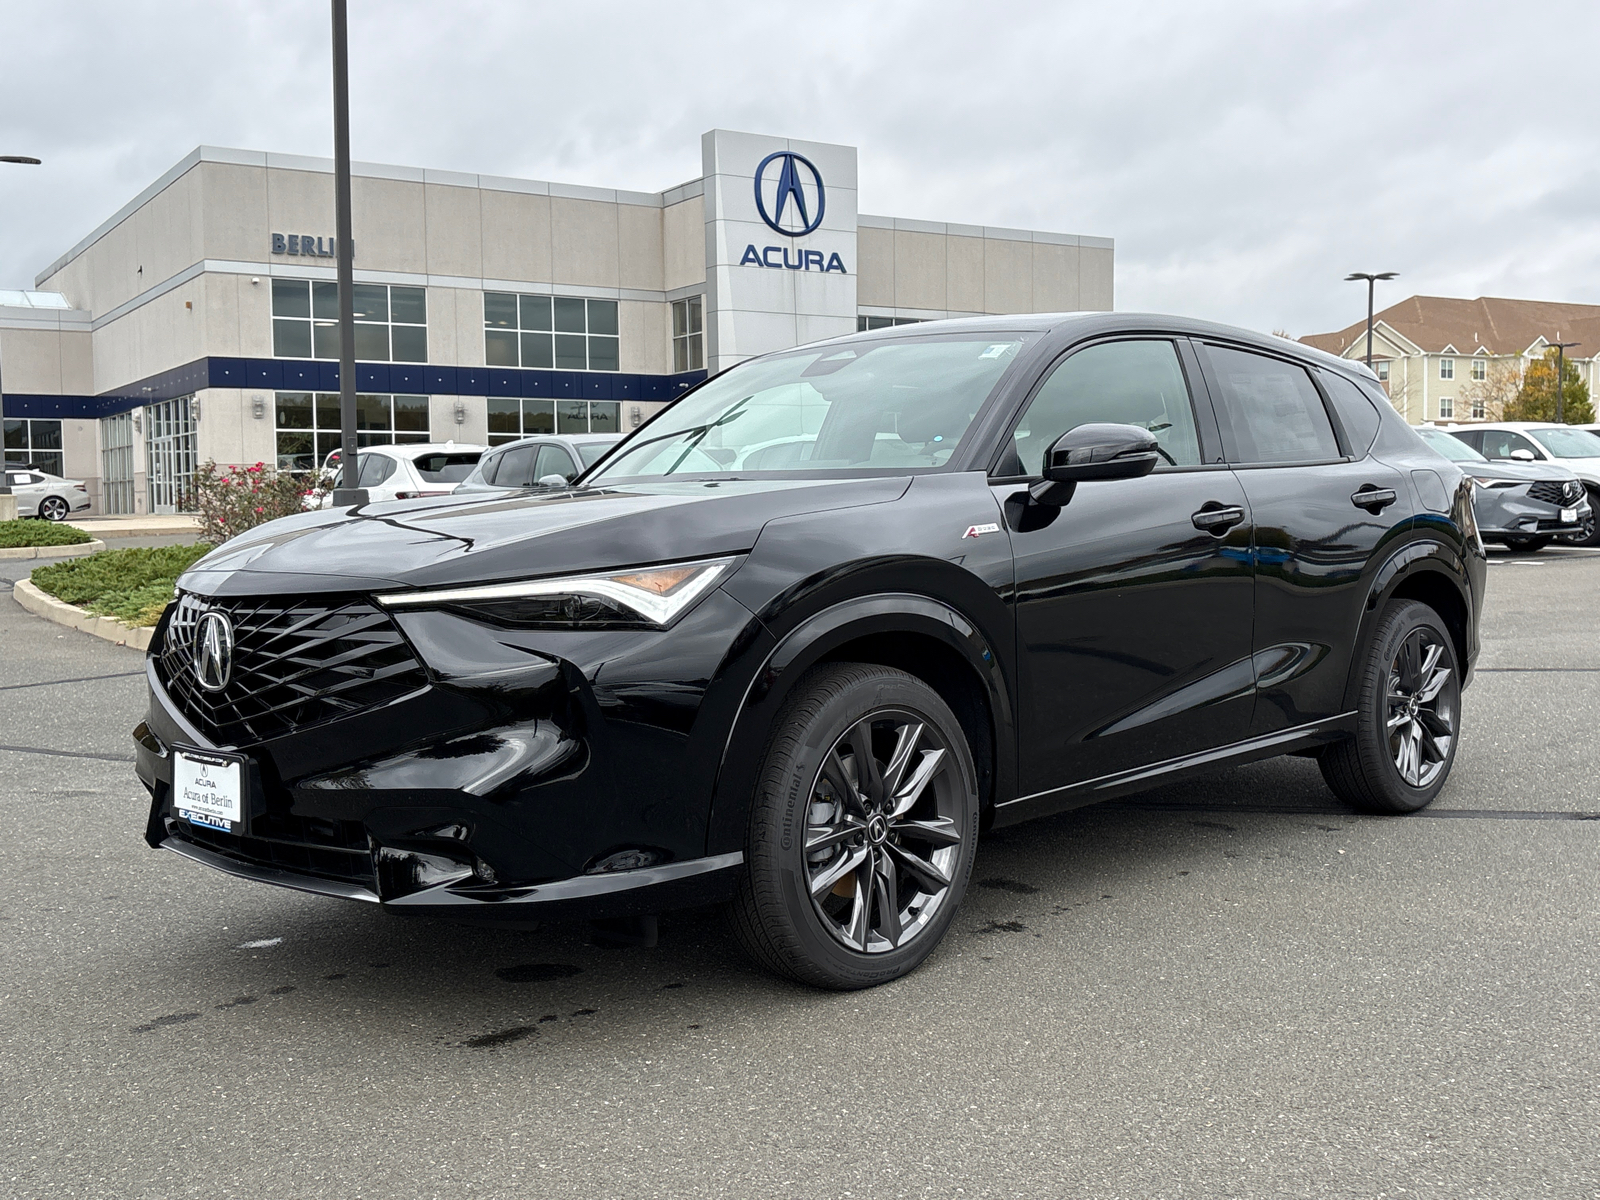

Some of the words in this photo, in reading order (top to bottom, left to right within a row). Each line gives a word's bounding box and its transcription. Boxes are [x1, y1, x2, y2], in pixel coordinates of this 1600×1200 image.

[271, 233, 354, 258] BERLI
[740, 244, 847, 274] ACURA
[195, 778, 216, 789] ACURA
[183, 787, 201, 802] Acura
[201, 792, 209, 804] of
[211, 793, 233, 808] Berlin
[178, 809, 231, 829] EXECUTIVE
[781, 773, 803, 851] Continental
